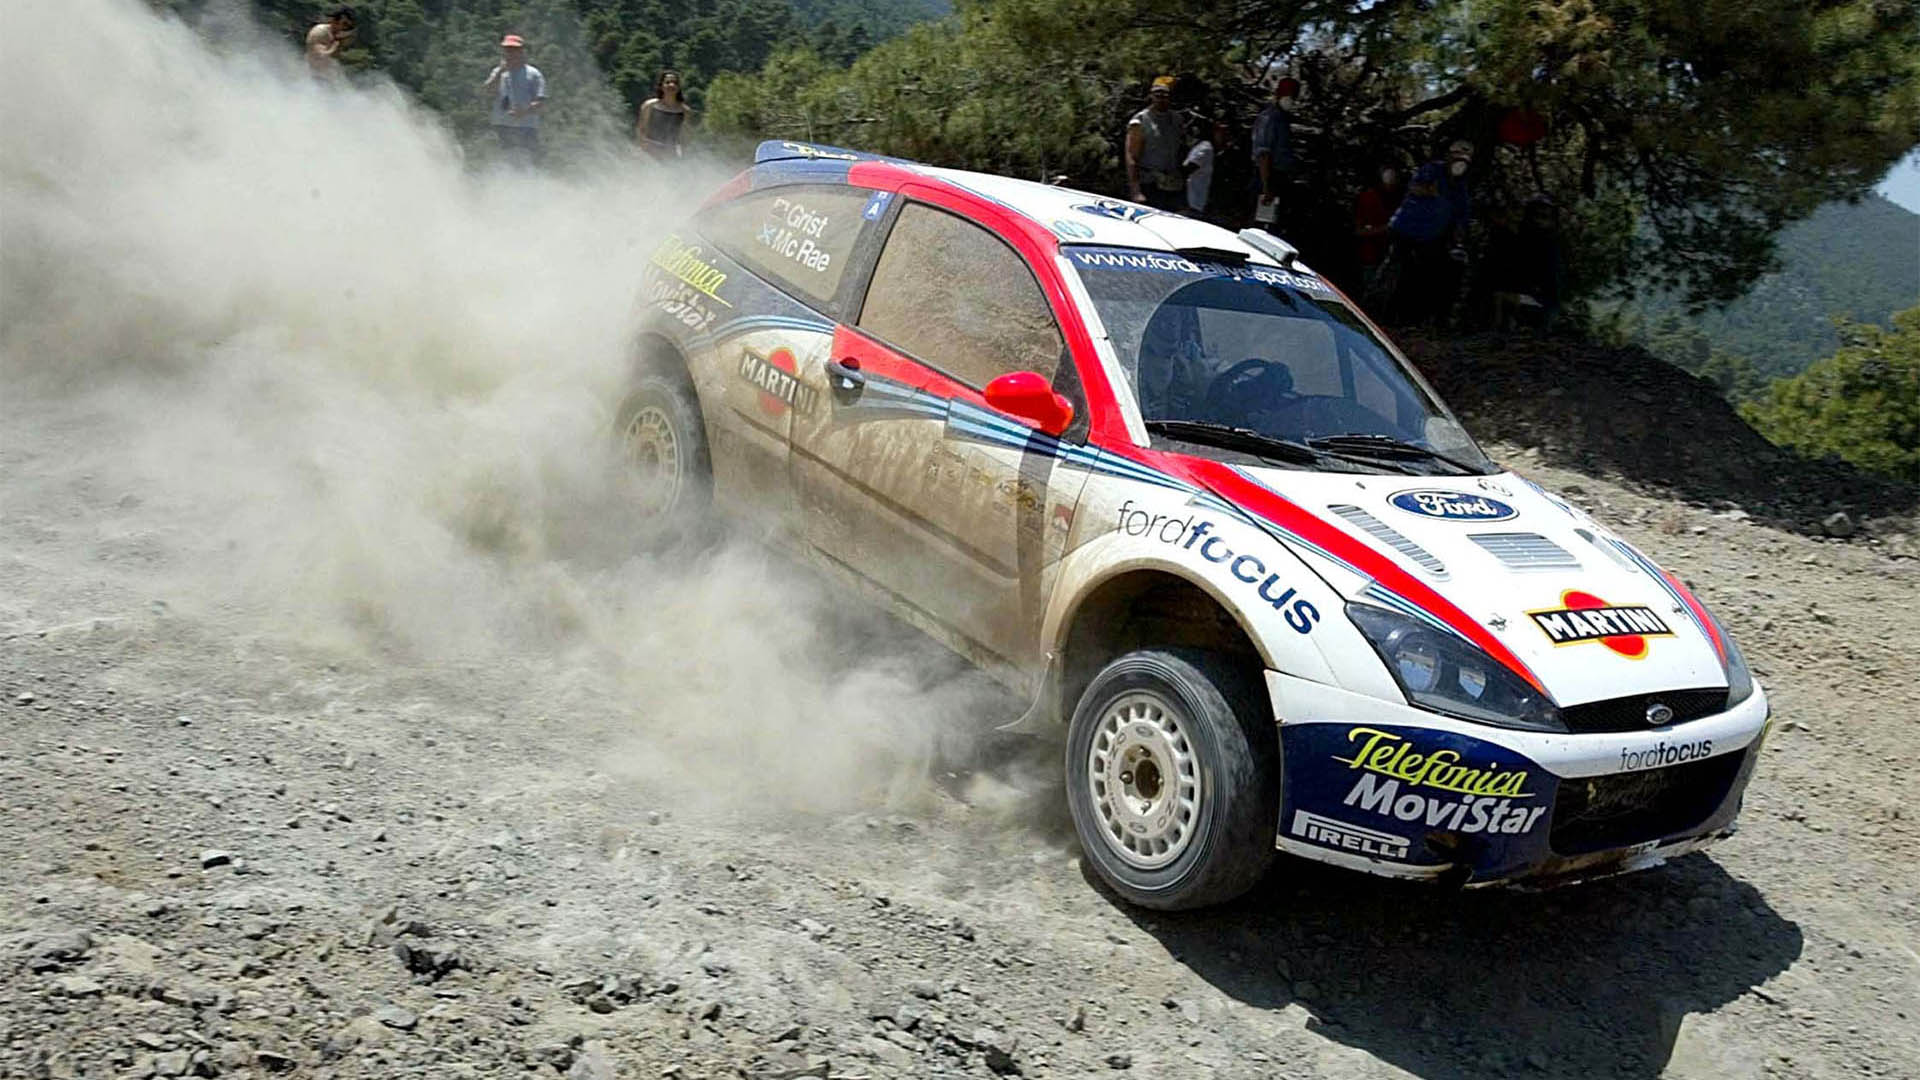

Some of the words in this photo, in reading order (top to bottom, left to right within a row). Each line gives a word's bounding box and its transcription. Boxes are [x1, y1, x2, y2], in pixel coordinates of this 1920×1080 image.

[786, 204, 829, 238] Grist
[796, 239, 830, 272] Rae
[741, 353, 816, 414] MARTINI
[1413, 492, 1498, 516] Ford
[1117, 500, 1321, 635] fordfocus
[1535, 608, 1668, 640] MARTINI
[1619, 739, 1713, 770] fordfocus
[1343, 773, 1547, 834] MoviStar
[1291, 809, 1412, 858] PIRELLI
